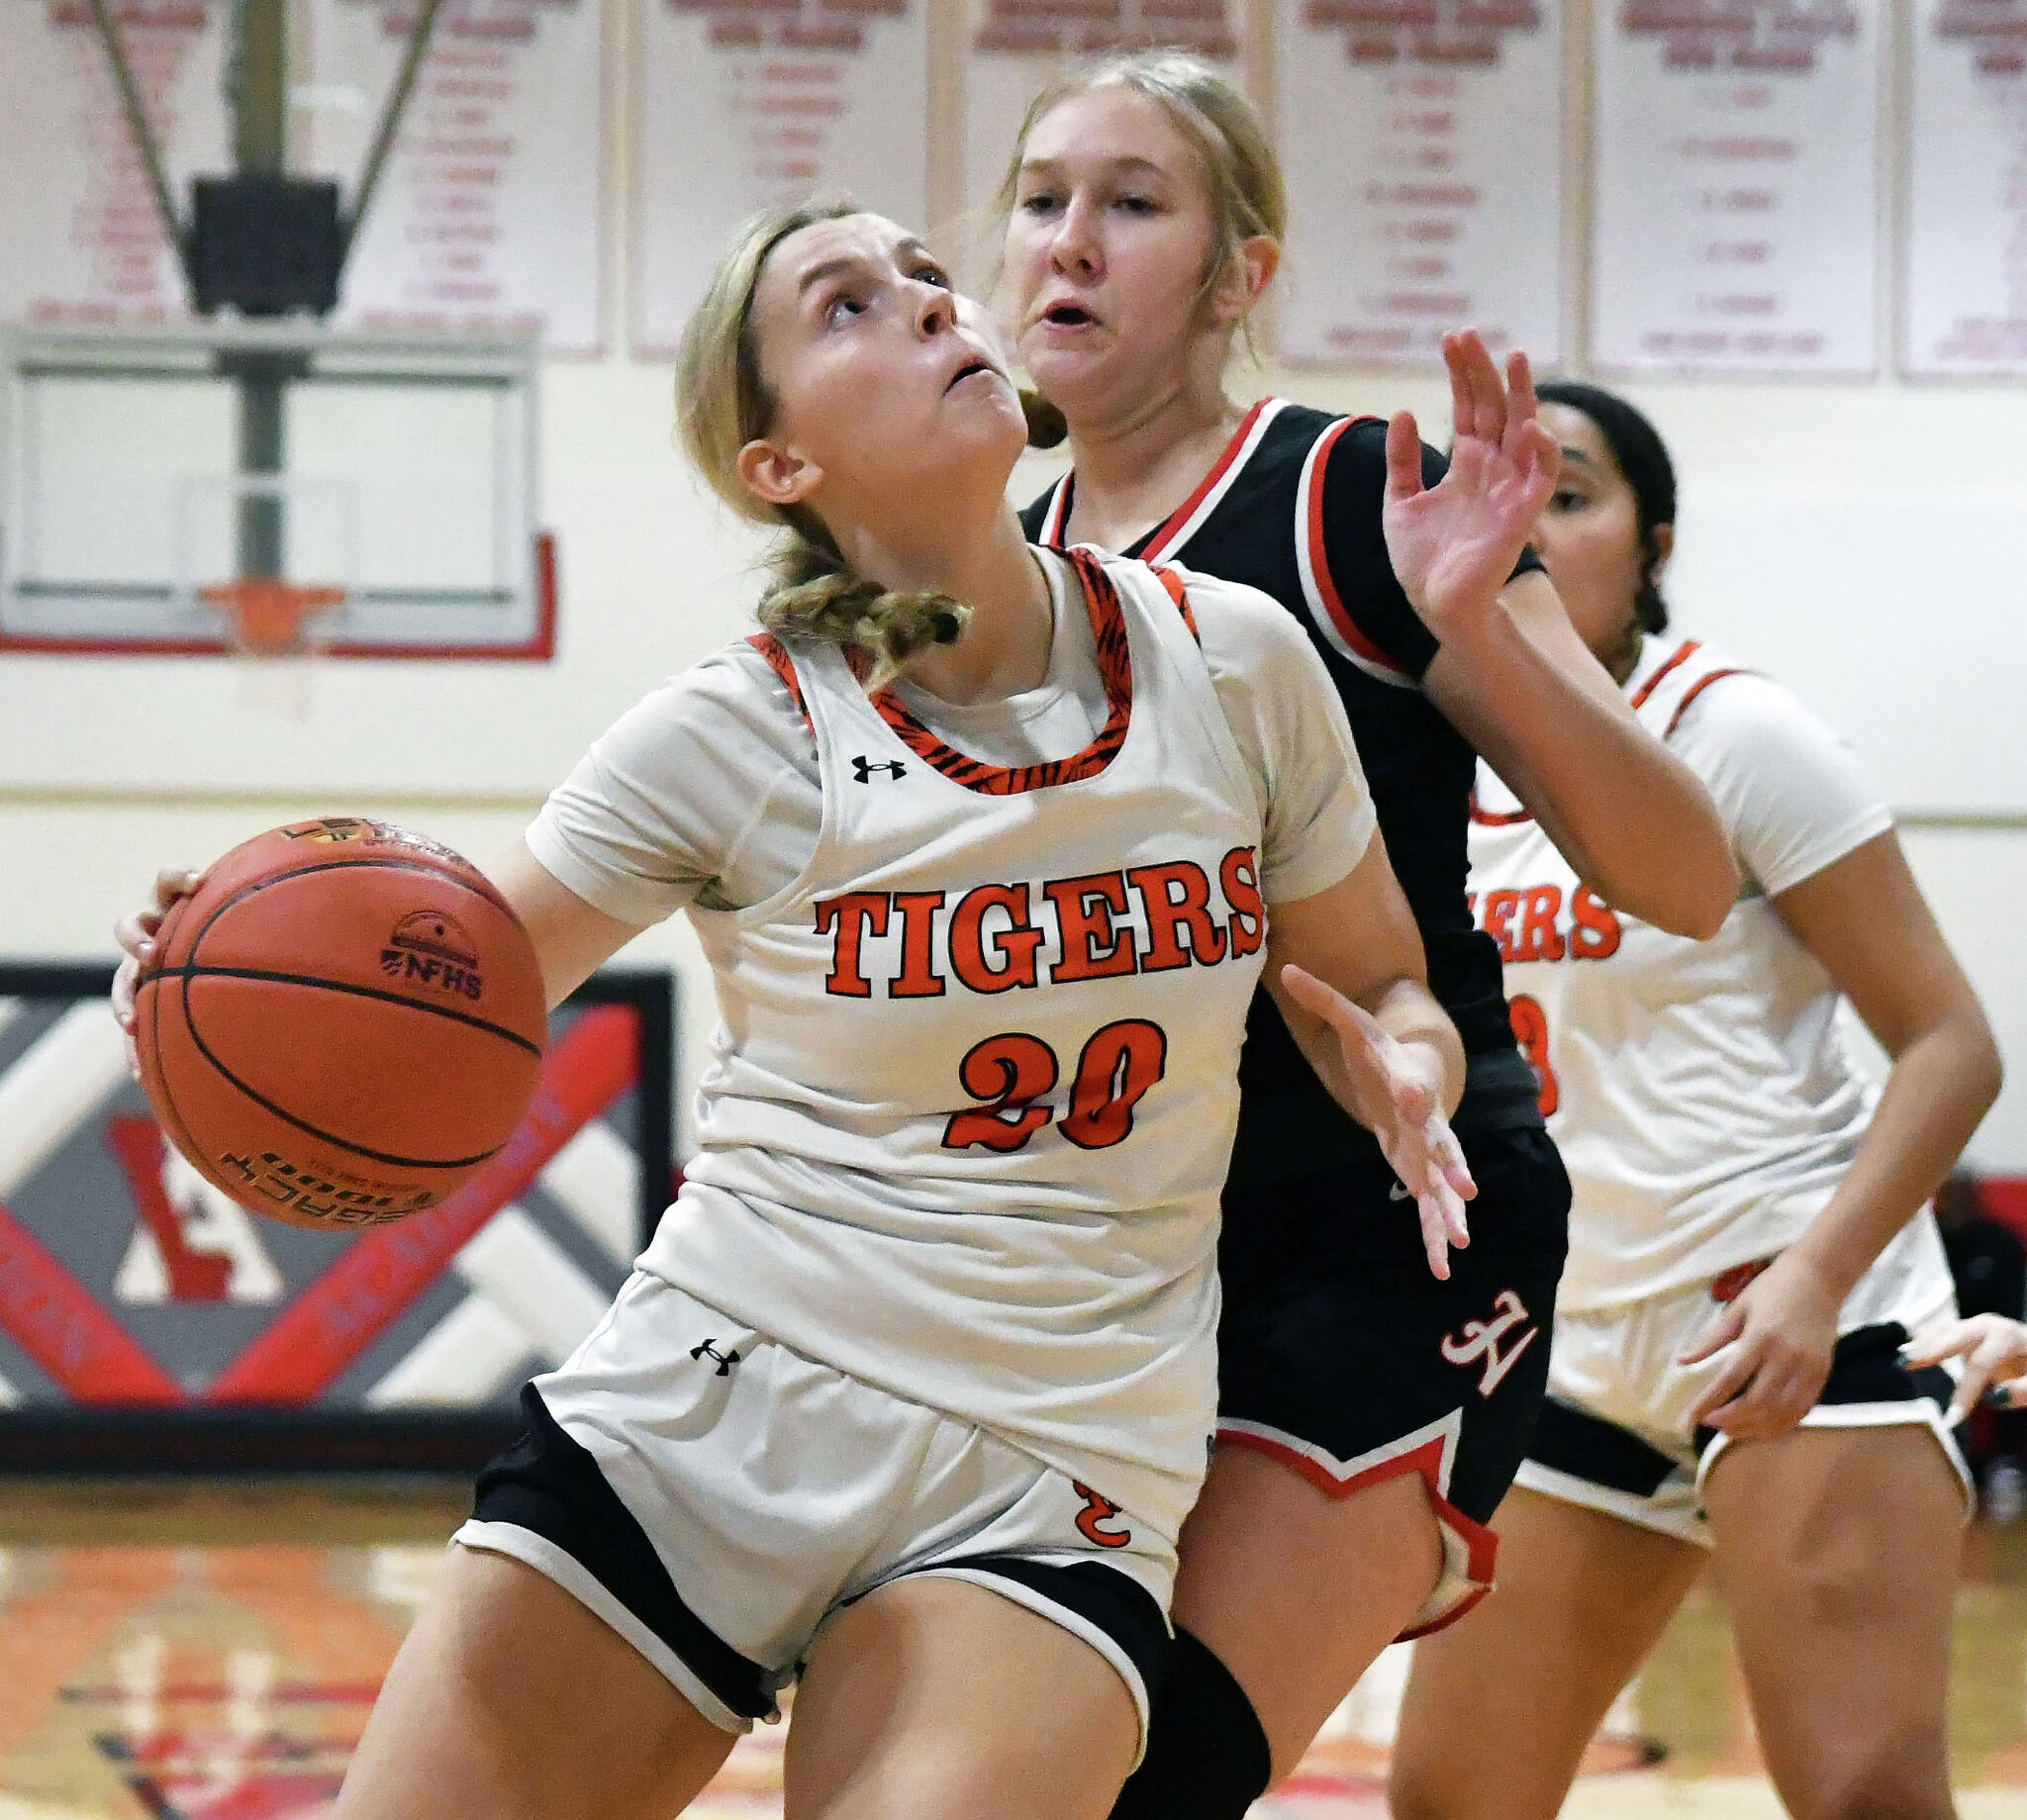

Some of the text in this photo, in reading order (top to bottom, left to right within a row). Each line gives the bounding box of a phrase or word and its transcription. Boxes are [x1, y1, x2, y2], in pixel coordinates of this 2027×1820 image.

[814, 845, 1266, 999] TIGERS
[1467, 884, 1620, 962] ERS
[405, 953, 482, 1002] NFHS
[941, 1018, 1167, 1153] 20
